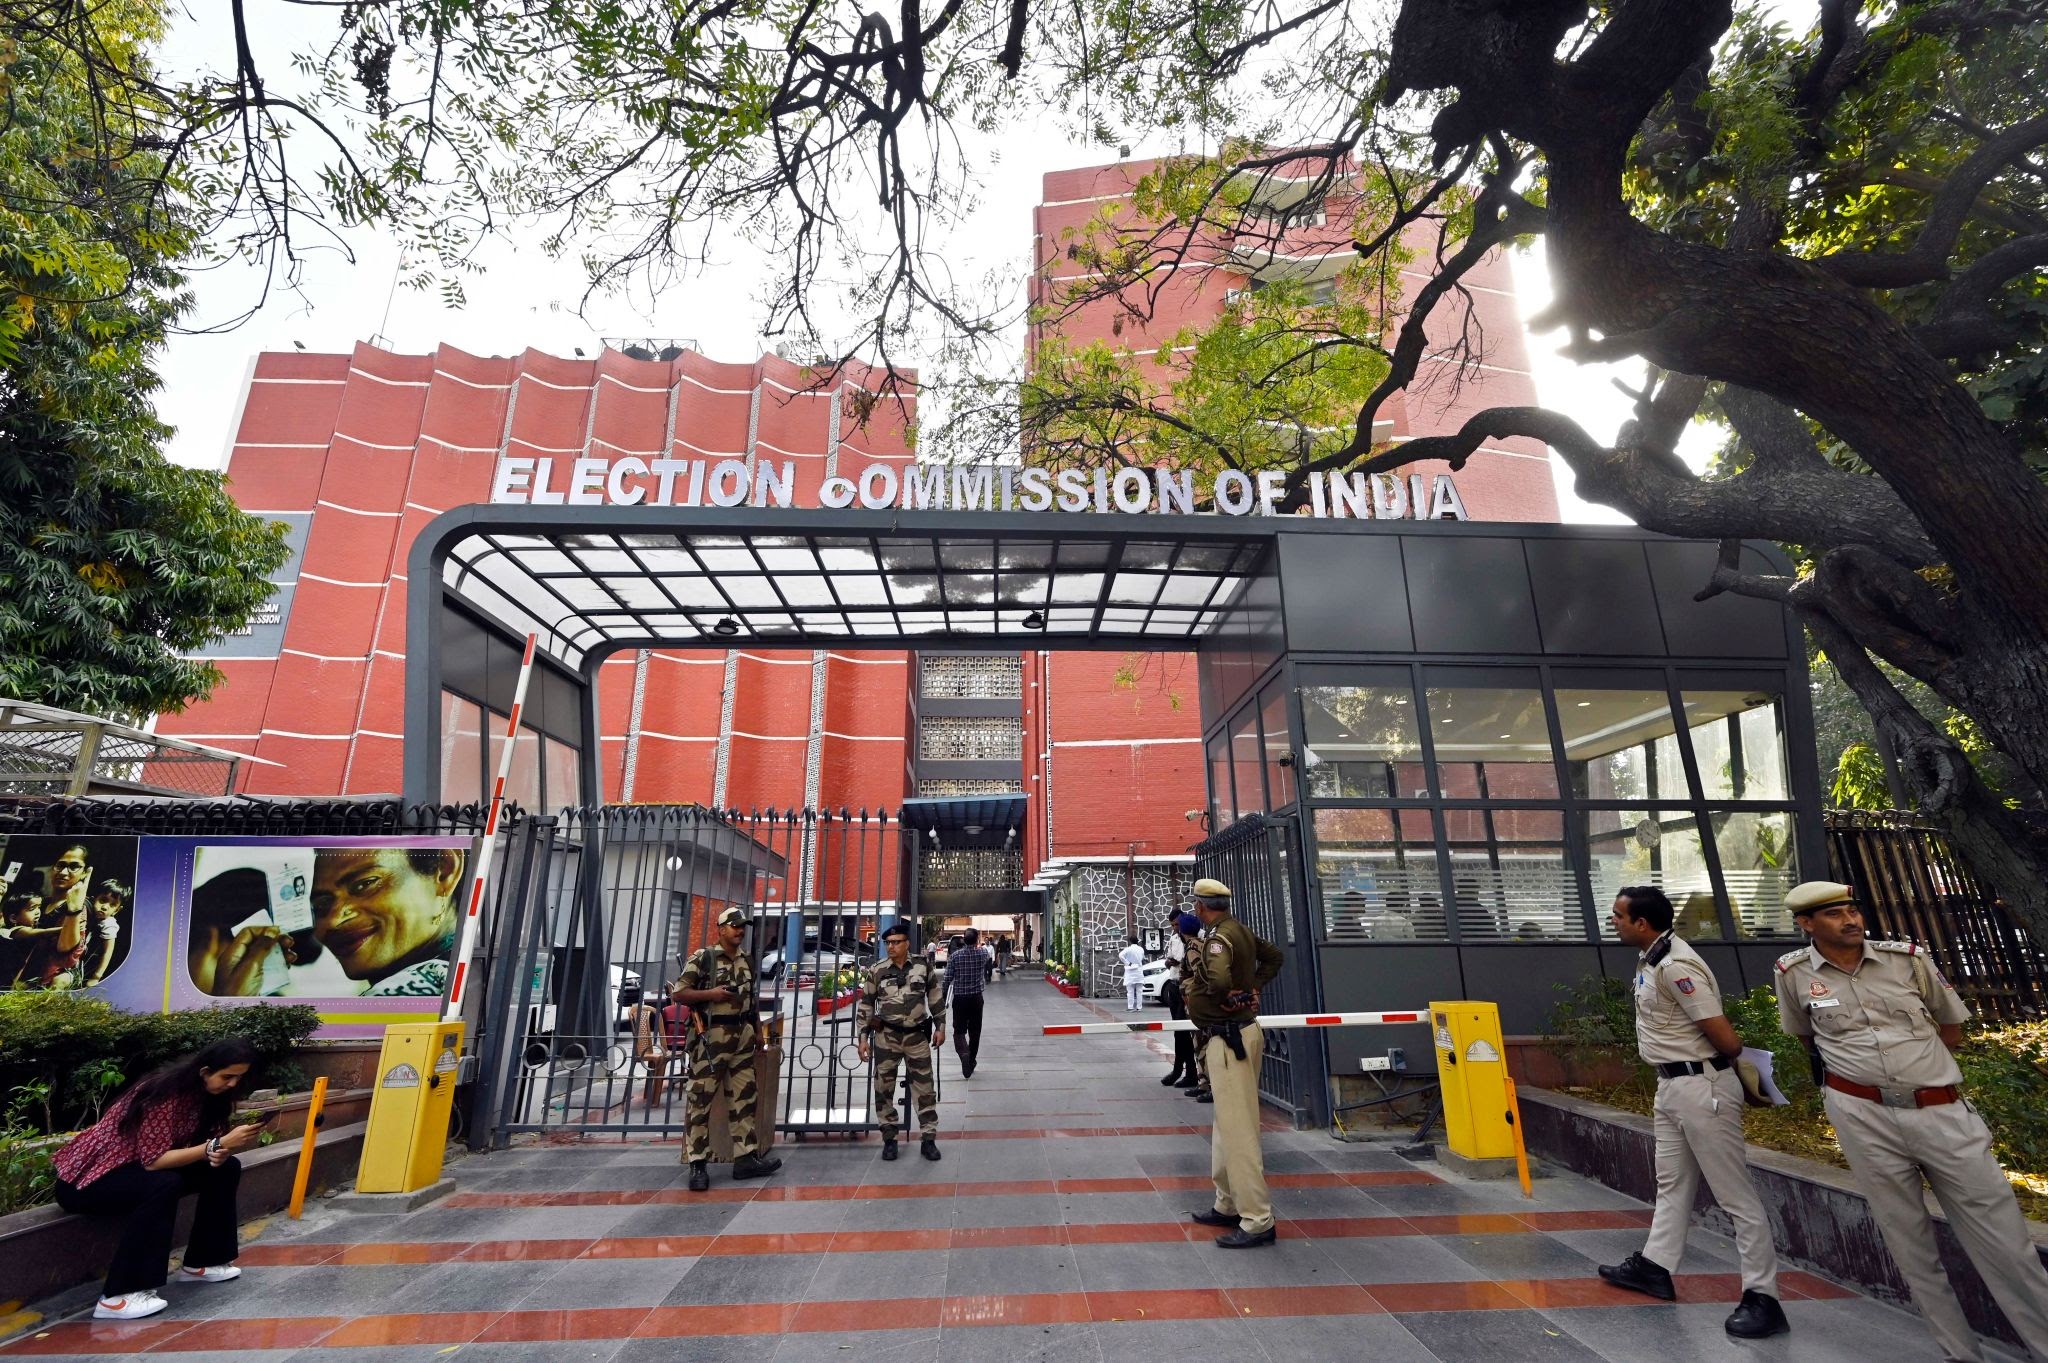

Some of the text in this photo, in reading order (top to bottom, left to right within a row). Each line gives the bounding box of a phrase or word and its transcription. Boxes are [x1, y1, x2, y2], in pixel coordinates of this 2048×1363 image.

[491, 456, 795, 507] ELECTION
[1214, 469, 1287, 516] OF
[1311, 471, 1470, 521] INDIA
